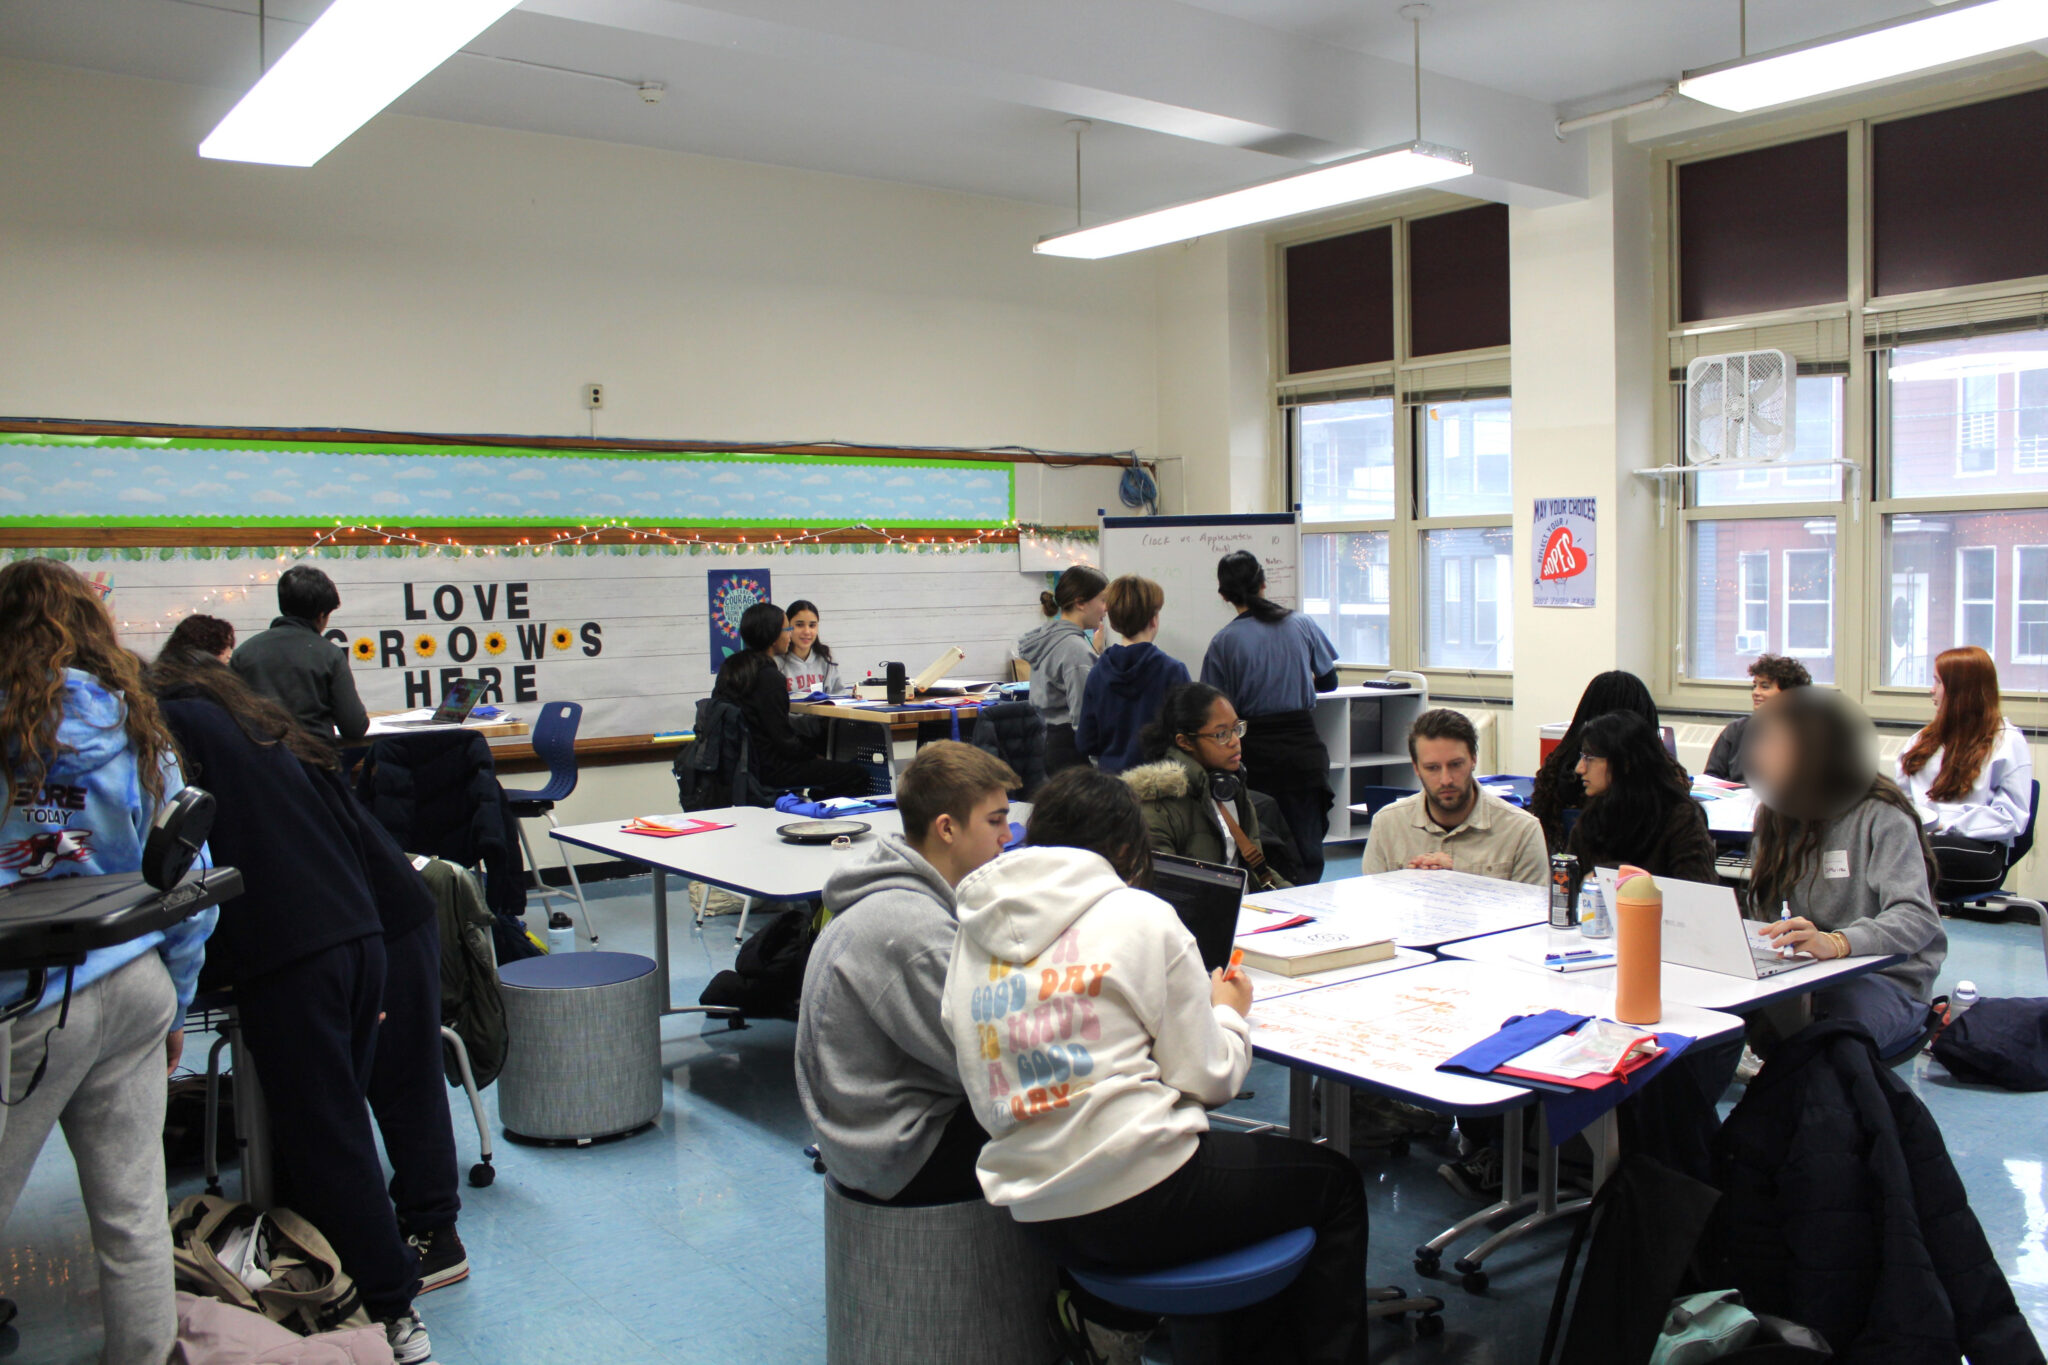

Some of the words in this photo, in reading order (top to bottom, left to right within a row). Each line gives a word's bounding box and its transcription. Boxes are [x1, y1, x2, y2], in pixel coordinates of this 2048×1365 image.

[1534, 500, 1546, 523] MAY
[1549, 499, 1566, 516] YOUR
[1569, 498, 1596, 522] CHOICES
[1547, 517, 1564, 533] YOUR
[1544, 533, 1576, 576] HOPES
[404, 583, 530, 621] LOVE
[404, 664, 538, 708] HERE
[22, 808, 73, 825] TODAY
[971, 973, 1027, 1023] GOOD
[1038, 963, 1112, 1001] DAY
[977, 1023, 1000, 1061] TO
[1007, 996, 1102, 1054] HAVE
[988, 1061, 1010, 1099] A
[1017, 1043, 1094, 1090] GOOD
[1011, 1083, 1070, 1121] DAY
